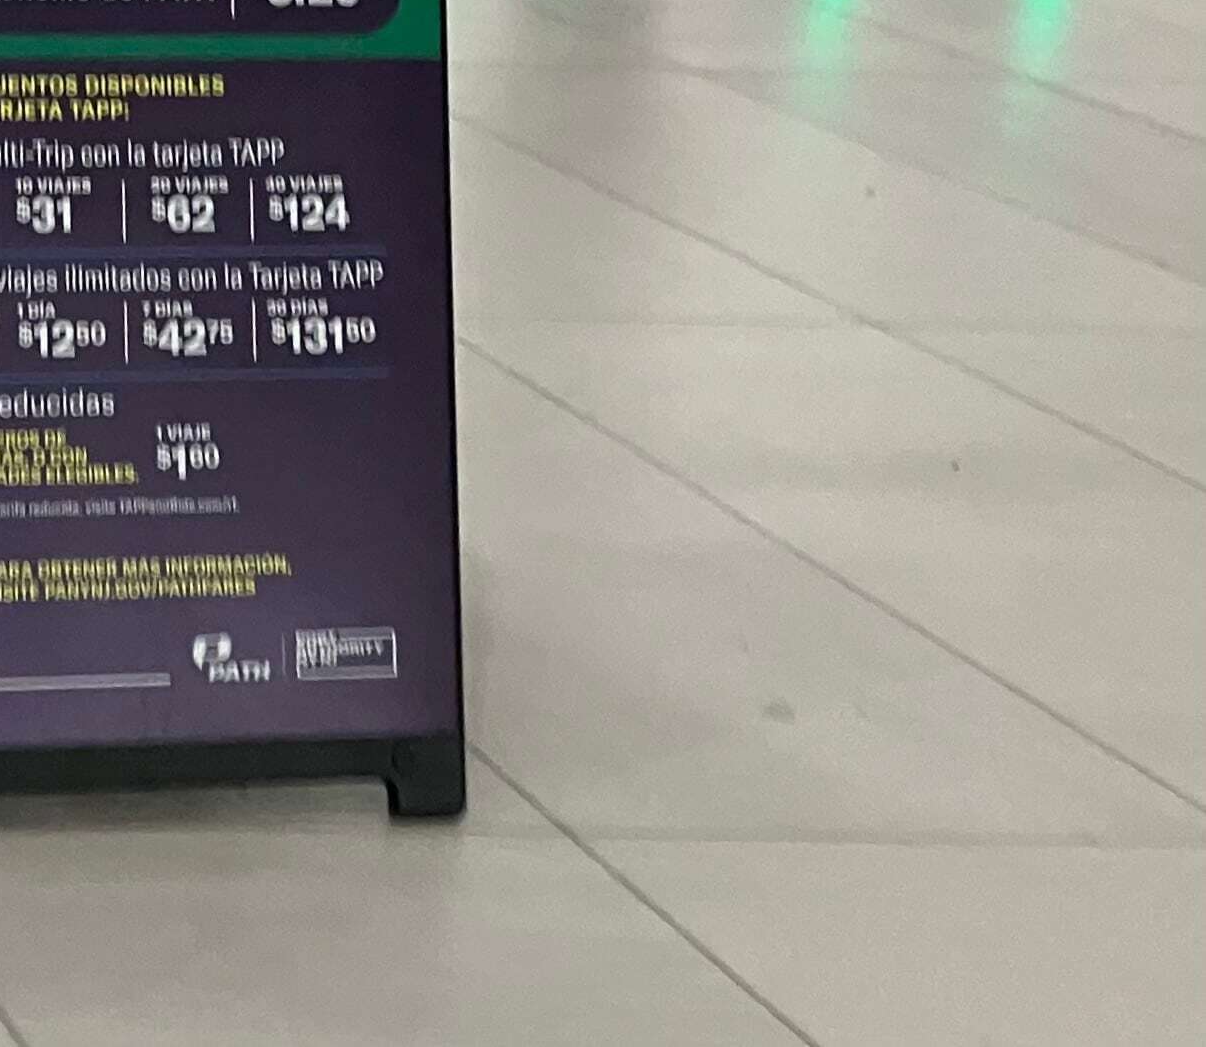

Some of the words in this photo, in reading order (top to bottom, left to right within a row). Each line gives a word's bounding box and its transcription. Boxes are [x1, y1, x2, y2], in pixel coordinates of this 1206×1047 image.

[85, 73, 224, 97] DISPONIBLES
[81, 142, 120, 168] con
[127, 138, 146, 167] la
[153, 138, 223, 173] tarjeta
[228, 136, 285, 167] TAPP
[37, 175, 92, 195] VIAJES
[174, 174, 228, 195] VIAJES
[289, 173, 343, 194] VIAJES
[16, 194, 72, 235] $31
[151, 193, 215, 234] $62
[268, 192, 350, 233] $124
[64, 261, 171, 294] ilimitados
[178, 266, 217, 292] con
[224, 261, 243, 291] la
[248, 260, 323, 296] Tarjeta
[328, 258, 384, 289] TAPP
[167, 422, 211, 442] VIAJE
[38, 557, 117, 580] OBTENER
